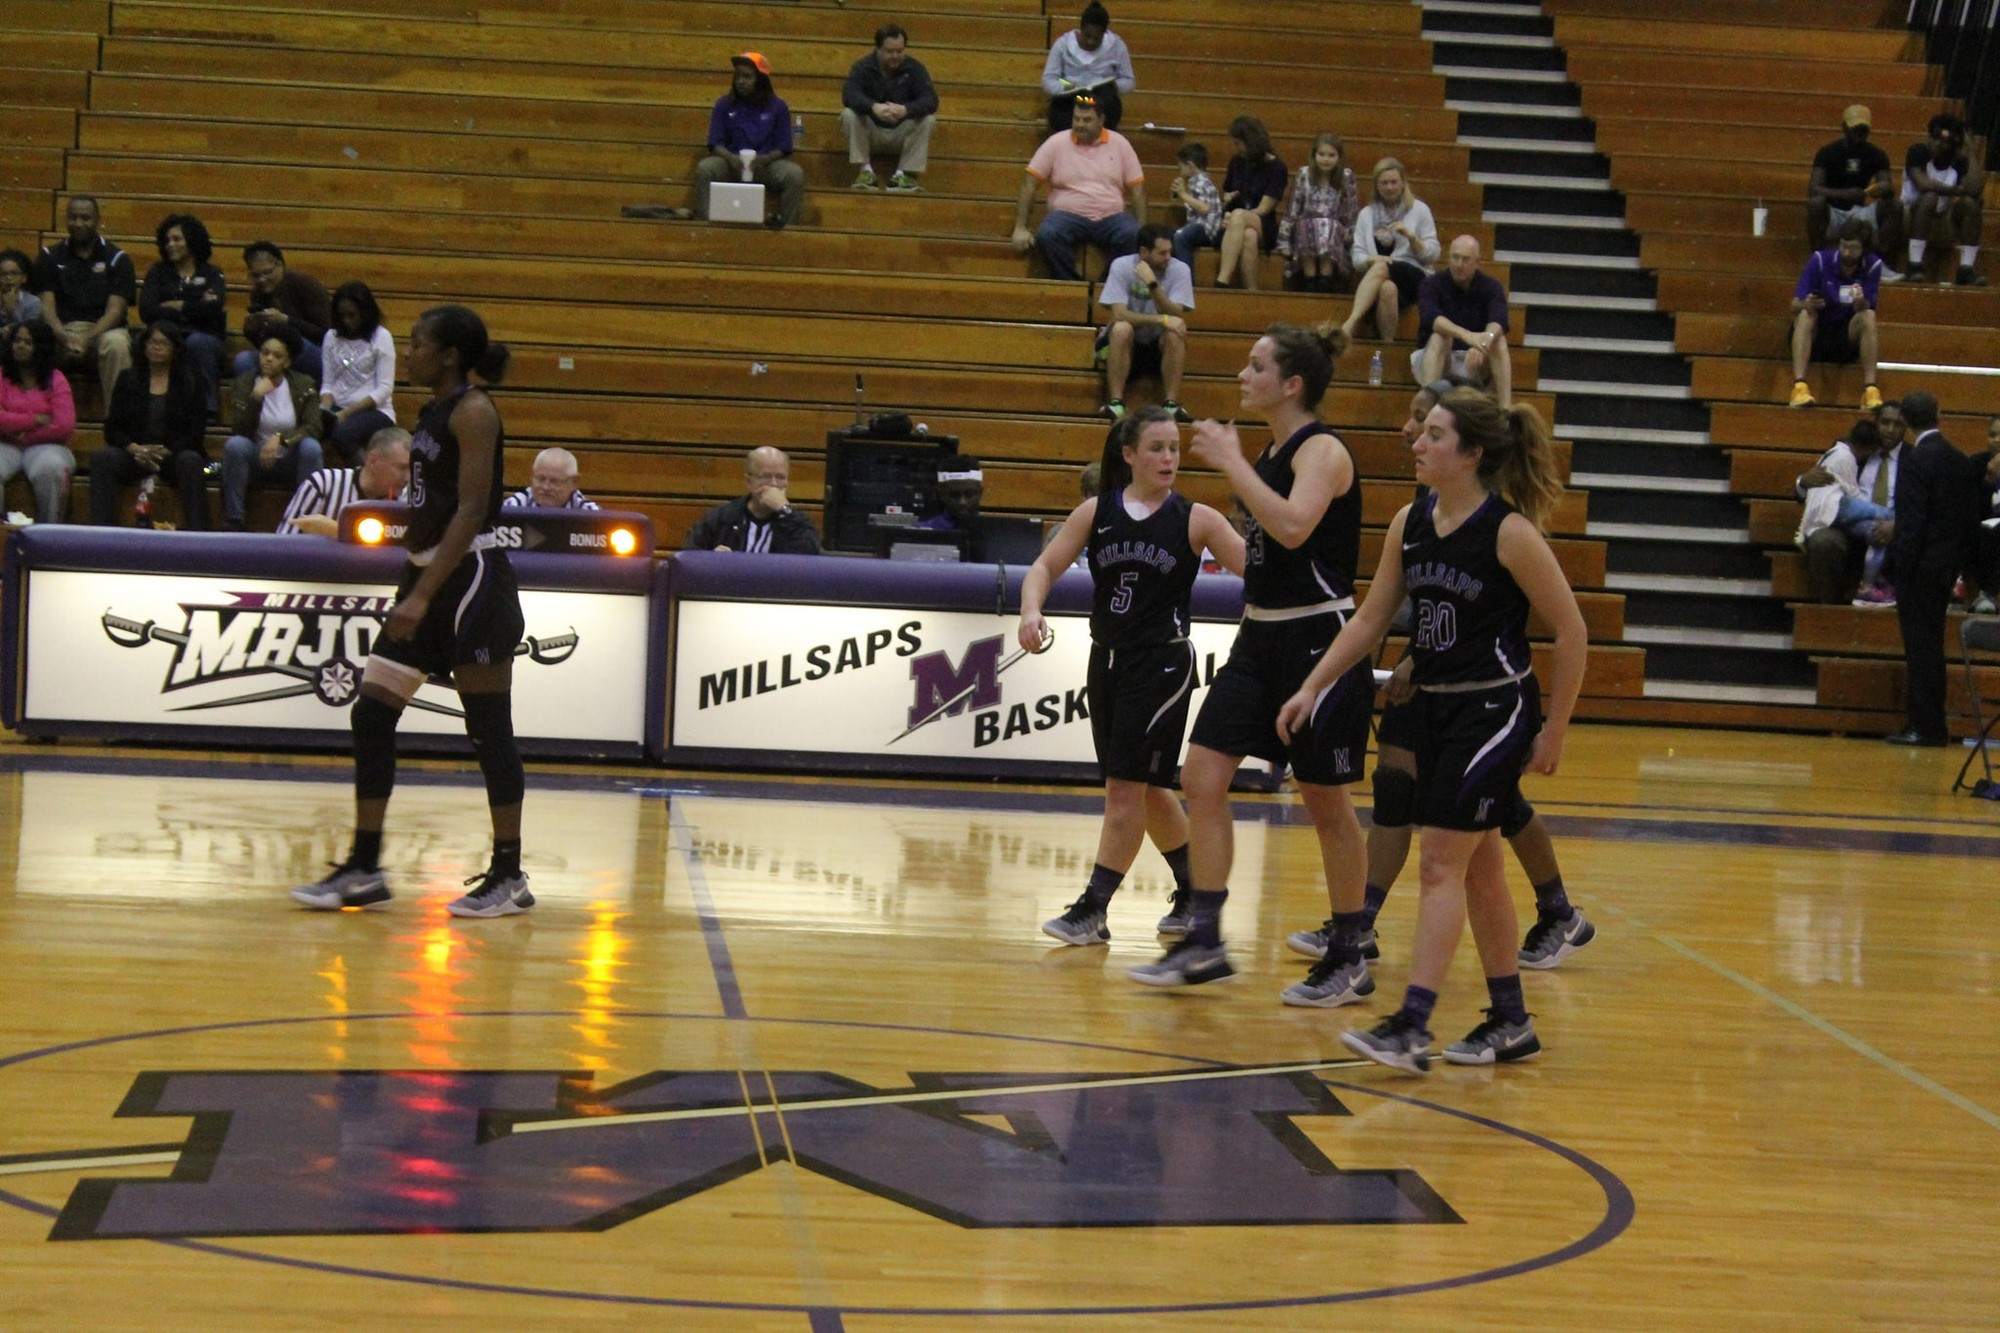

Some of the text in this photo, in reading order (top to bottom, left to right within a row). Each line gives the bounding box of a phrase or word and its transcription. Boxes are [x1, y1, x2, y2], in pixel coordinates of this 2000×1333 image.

[384, 524, 409, 539] BON
[492, 526, 522, 548] SS
[569, 532, 607, 548] BONUS
[1096, 541, 1177, 574] MILLSAPS
[1110, 572, 1139, 614] 5
[1416, 598, 1456, 652] 20
[170, 610, 382, 685] MAJO
[698, 620, 922, 711] MILLSAPS
[907, 633, 1004, 731] M
